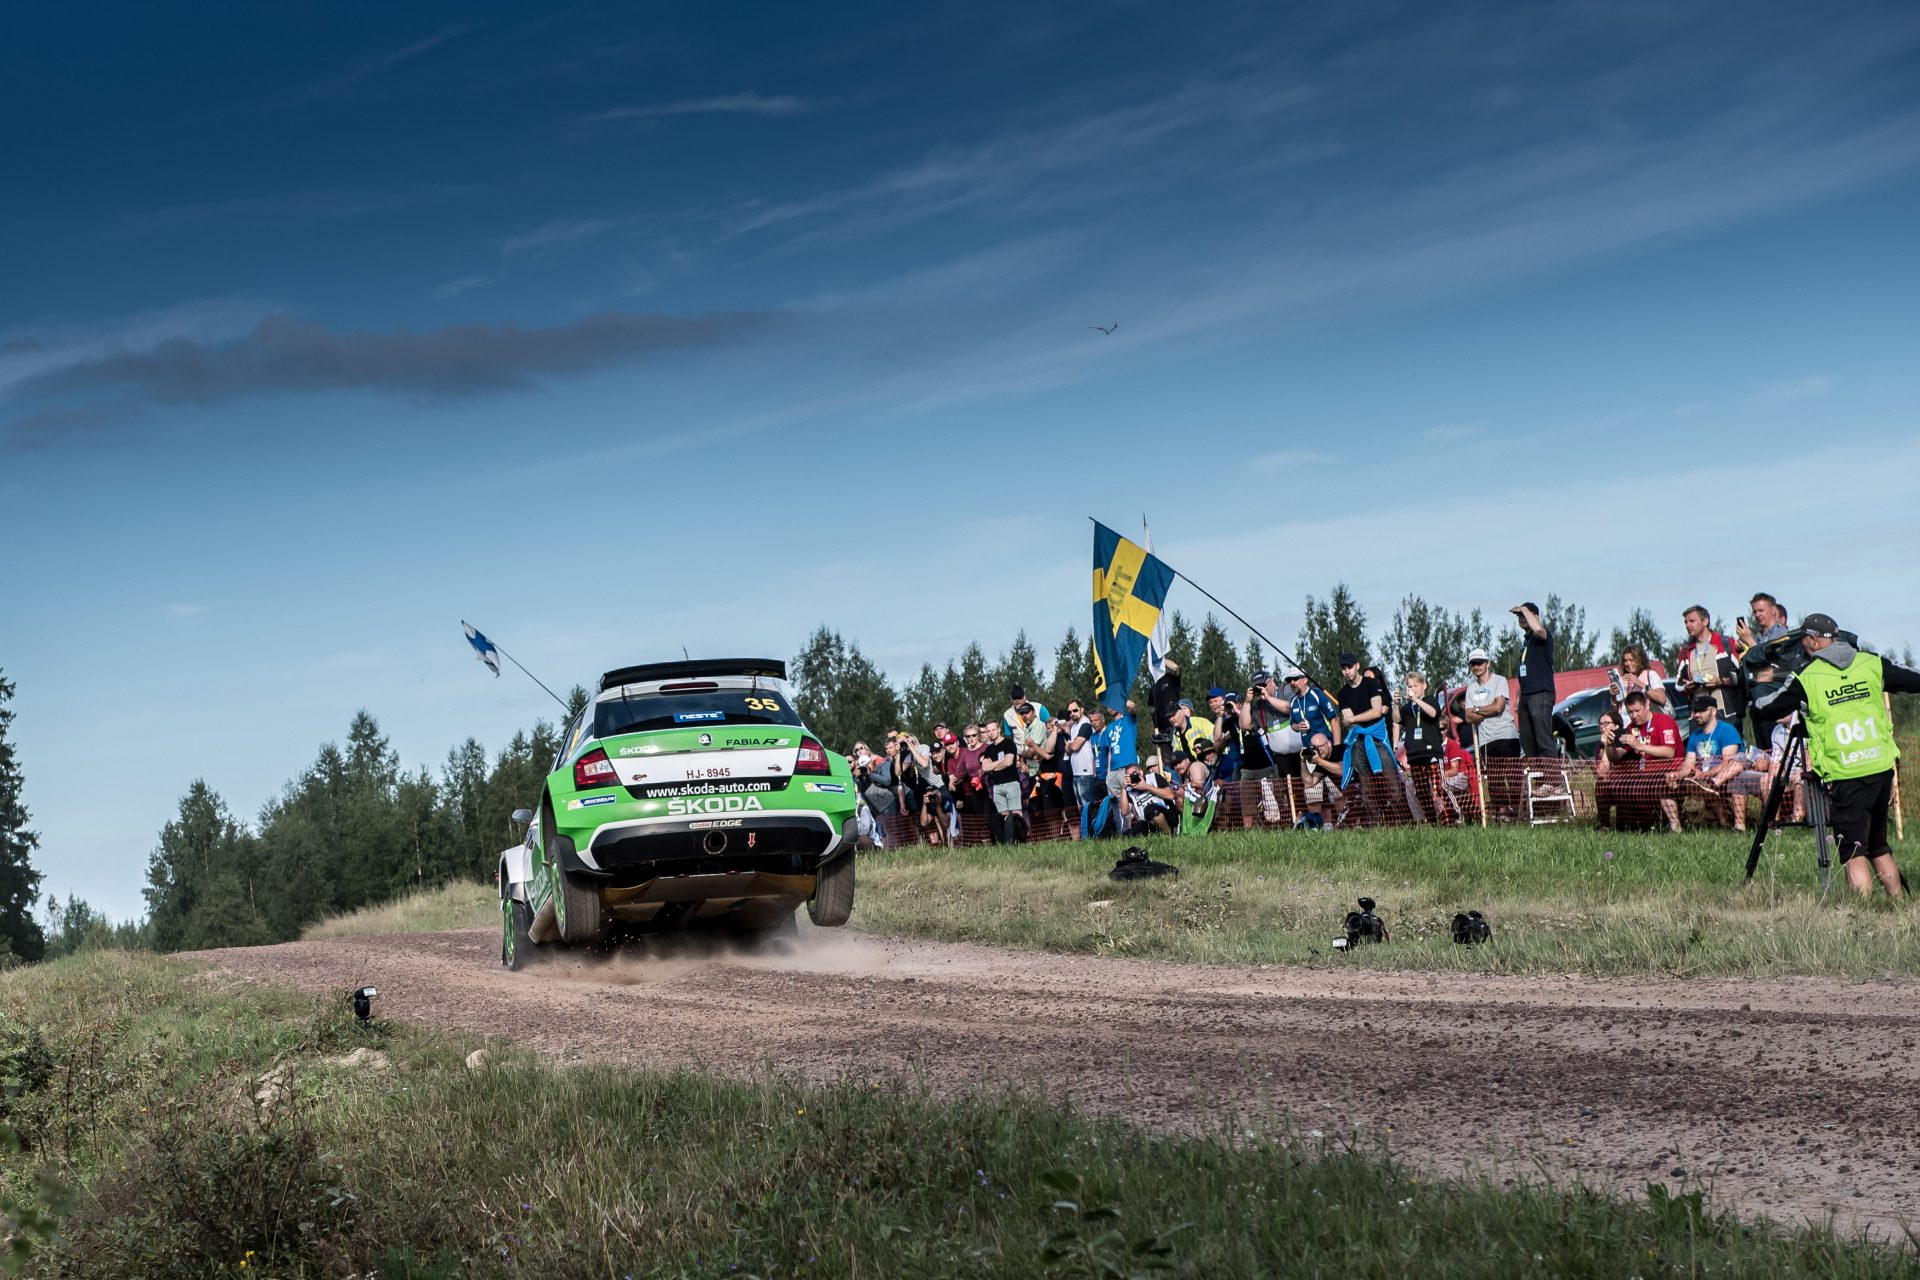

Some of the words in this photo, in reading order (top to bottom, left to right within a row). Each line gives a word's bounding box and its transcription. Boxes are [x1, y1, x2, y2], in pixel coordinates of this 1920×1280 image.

[1825, 681, 1868, 698] WRC
[745, 697, 780, 711] 35
[1836, 716, 1877, 745] 061
[726, 738, 760, 746] FABIA
[1840, 748, 1880, 765] Lexar
[646, 782, 771, 798] www.skoda-auto.com
[667, 796, 763, 816] ŠKODA
[712, 819, 743, 828] EDGE
